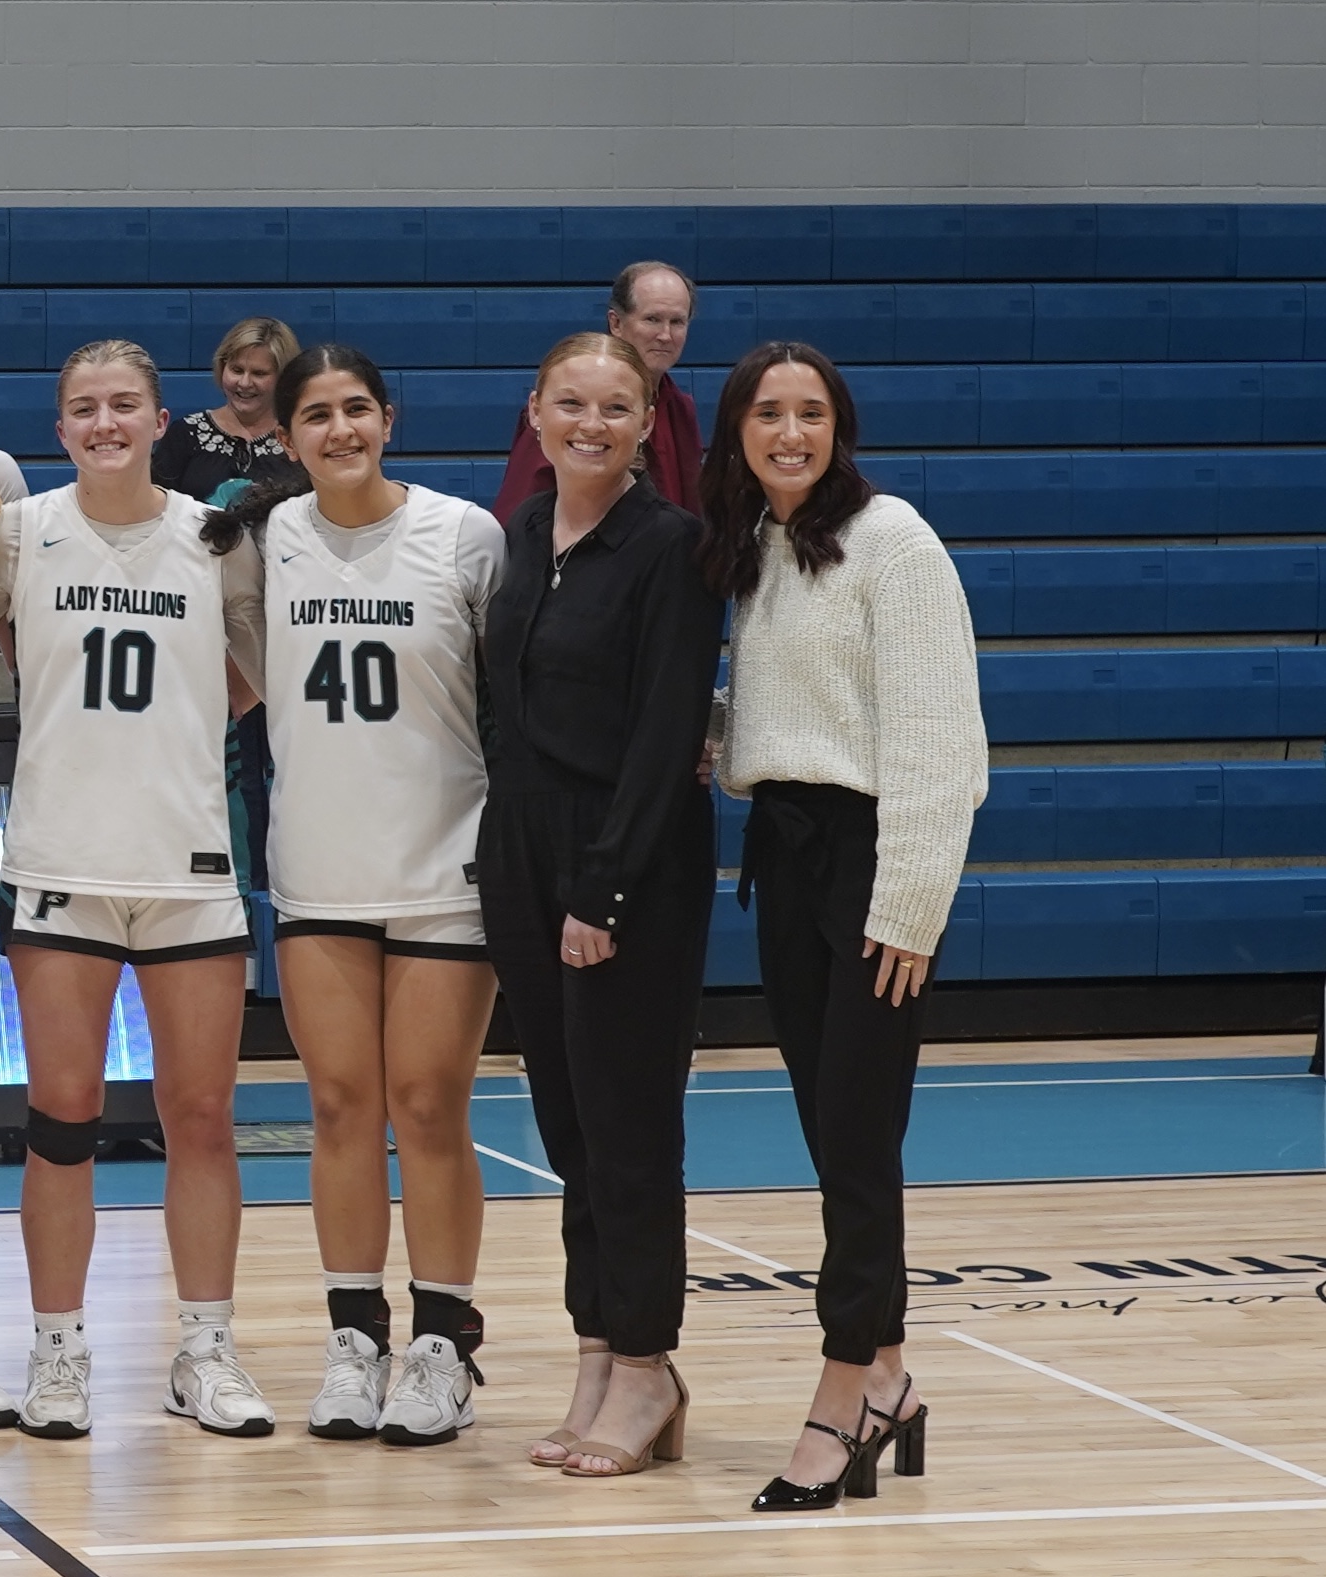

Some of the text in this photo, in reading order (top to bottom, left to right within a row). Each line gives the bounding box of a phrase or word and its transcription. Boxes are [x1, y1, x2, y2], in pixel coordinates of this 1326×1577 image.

[55, 586, 186, 619] LADY STALLIONS
[290, 598, 414, 627] LADY STALLIONS
[83, 626, 156, 713] 10
[304, 640, 399, 723] 40
[685, 1265, 1052, 1293] COUR
